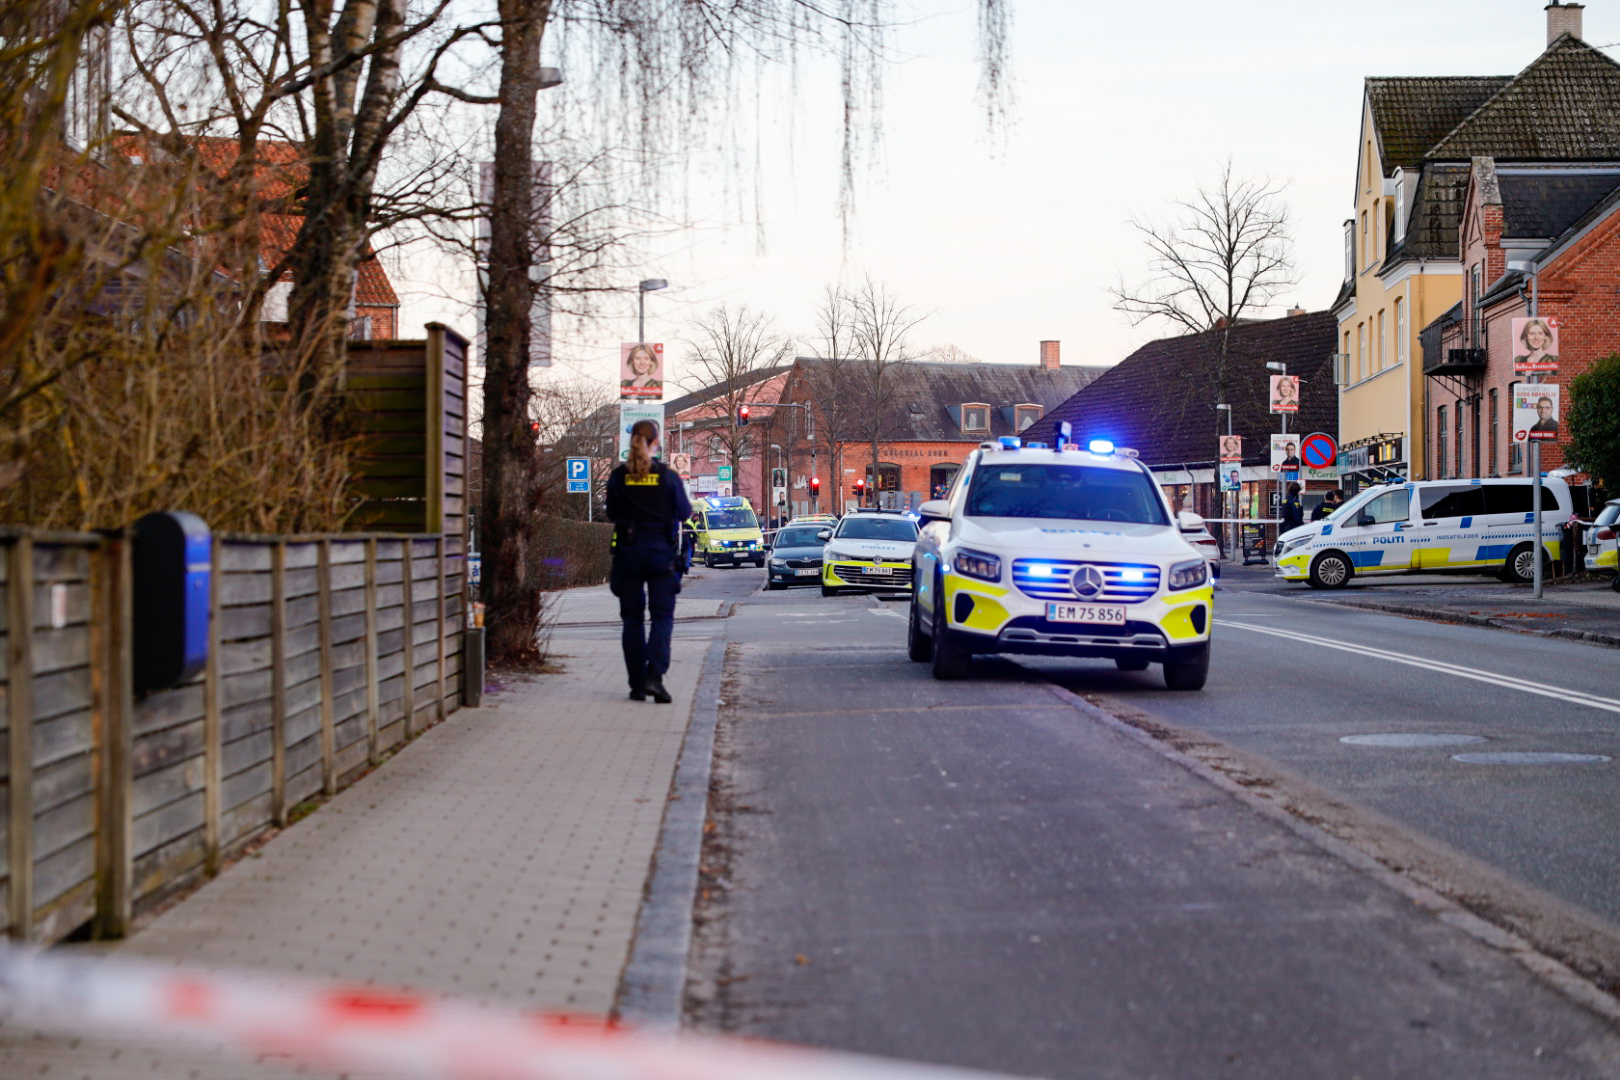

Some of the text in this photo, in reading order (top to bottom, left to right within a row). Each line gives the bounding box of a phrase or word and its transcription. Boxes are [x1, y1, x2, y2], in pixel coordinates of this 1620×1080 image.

[572, 461, 584, 478] P
[1373, 535, 1405, 544] POLITI
[1058, 606, 1123, 621] EM 75 856
